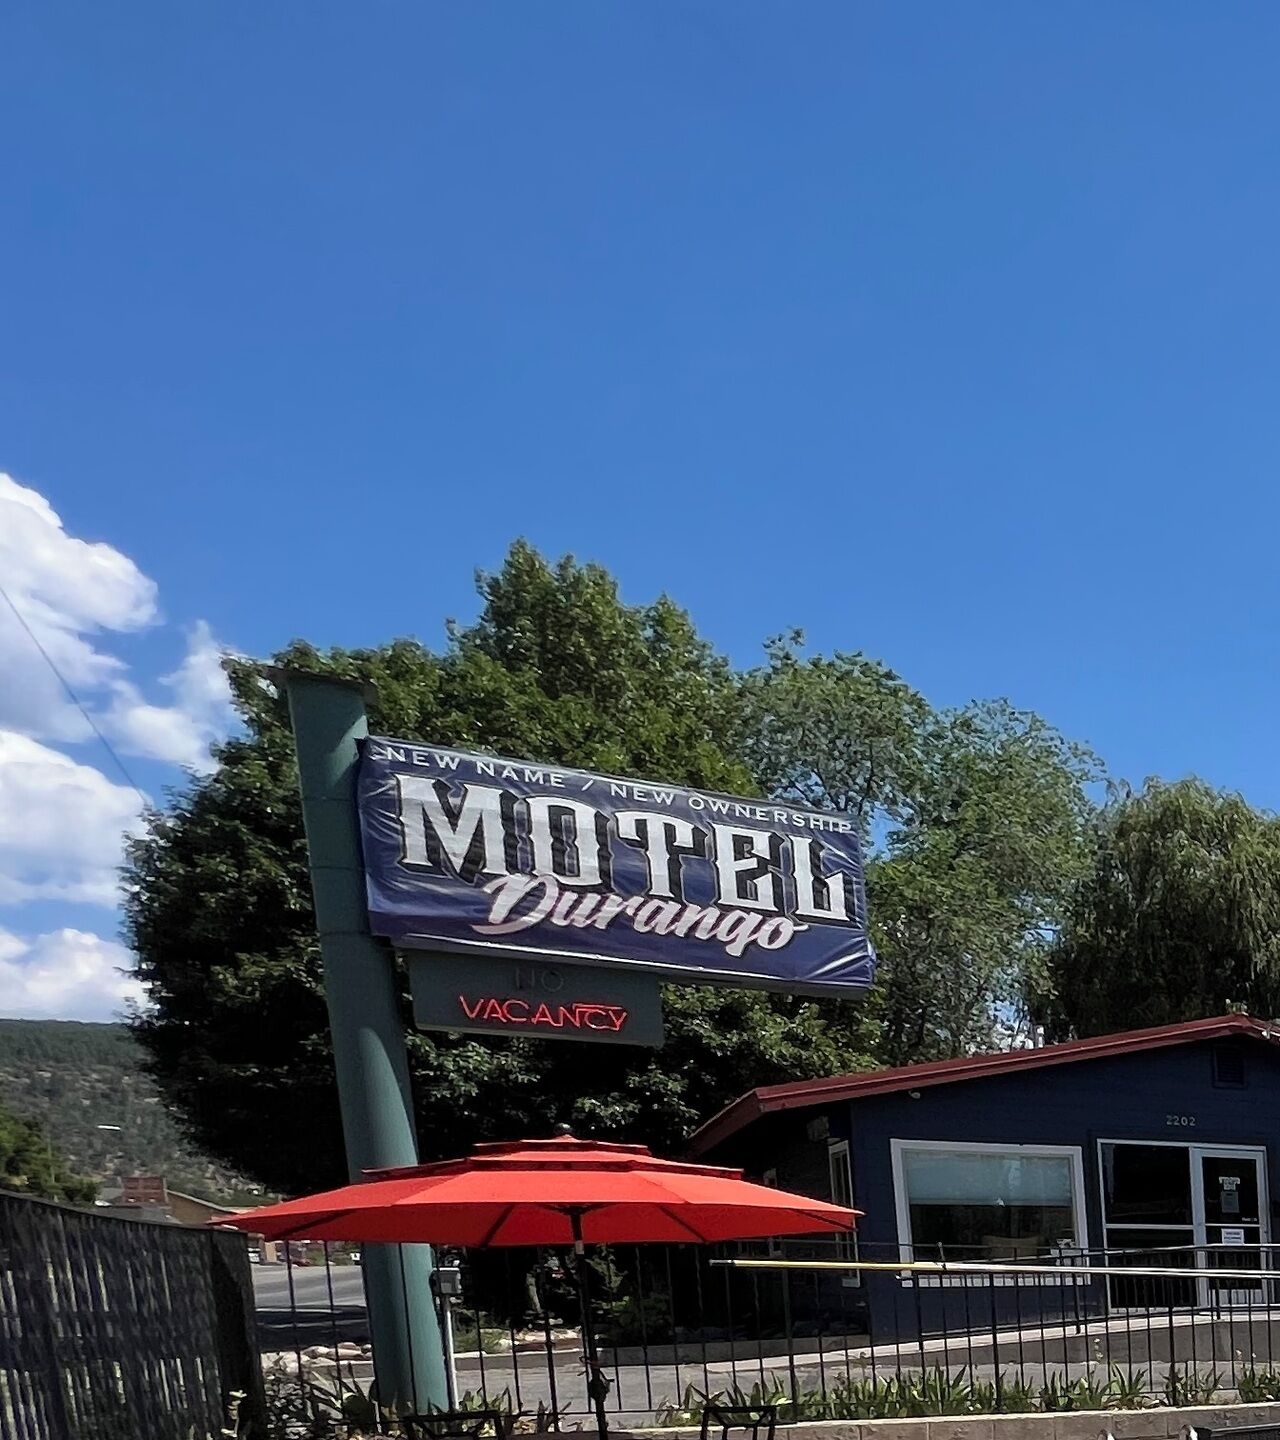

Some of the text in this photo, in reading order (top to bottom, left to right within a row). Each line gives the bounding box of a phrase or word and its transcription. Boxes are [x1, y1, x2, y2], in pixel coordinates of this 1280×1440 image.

[386, 746, 461, 771] NEW
[476, 761, 566, 788] NAME
[610, 784, 675, 806] NEW
[688, 797, 852, 833] OWNERSHIP
[396, 774, 849, 922] MOTEL
[472, 872, 811, 957] Durango
[459, 995, 628, 1032] VACANCY
[1165, 1114, 1196, 1126] 2202
